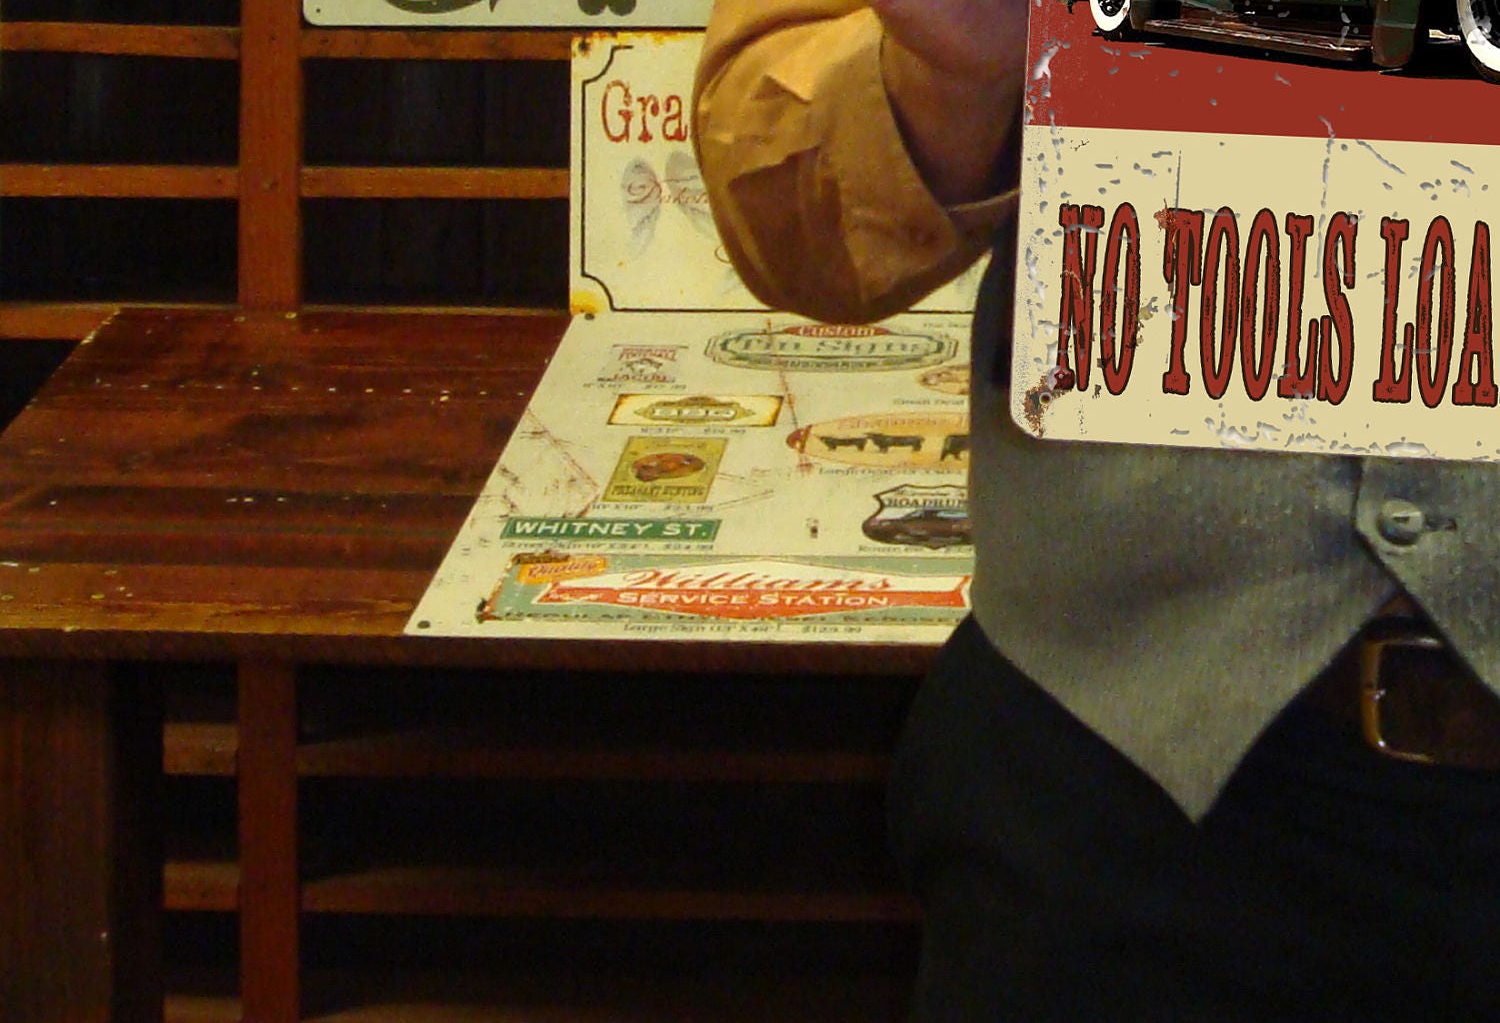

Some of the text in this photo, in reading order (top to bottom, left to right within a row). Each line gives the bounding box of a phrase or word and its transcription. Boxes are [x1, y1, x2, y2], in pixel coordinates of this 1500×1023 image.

[1053, 201, 1142, 396] NO
[1161, 206, 1360, 407] TOOLS
[514, 521, 708, 537] WHITNEY ST.
[623, 567, 893, 591] Williams
[616, 591, 748, 606] SERVICE
[758, 592, 890, 607] STATION
